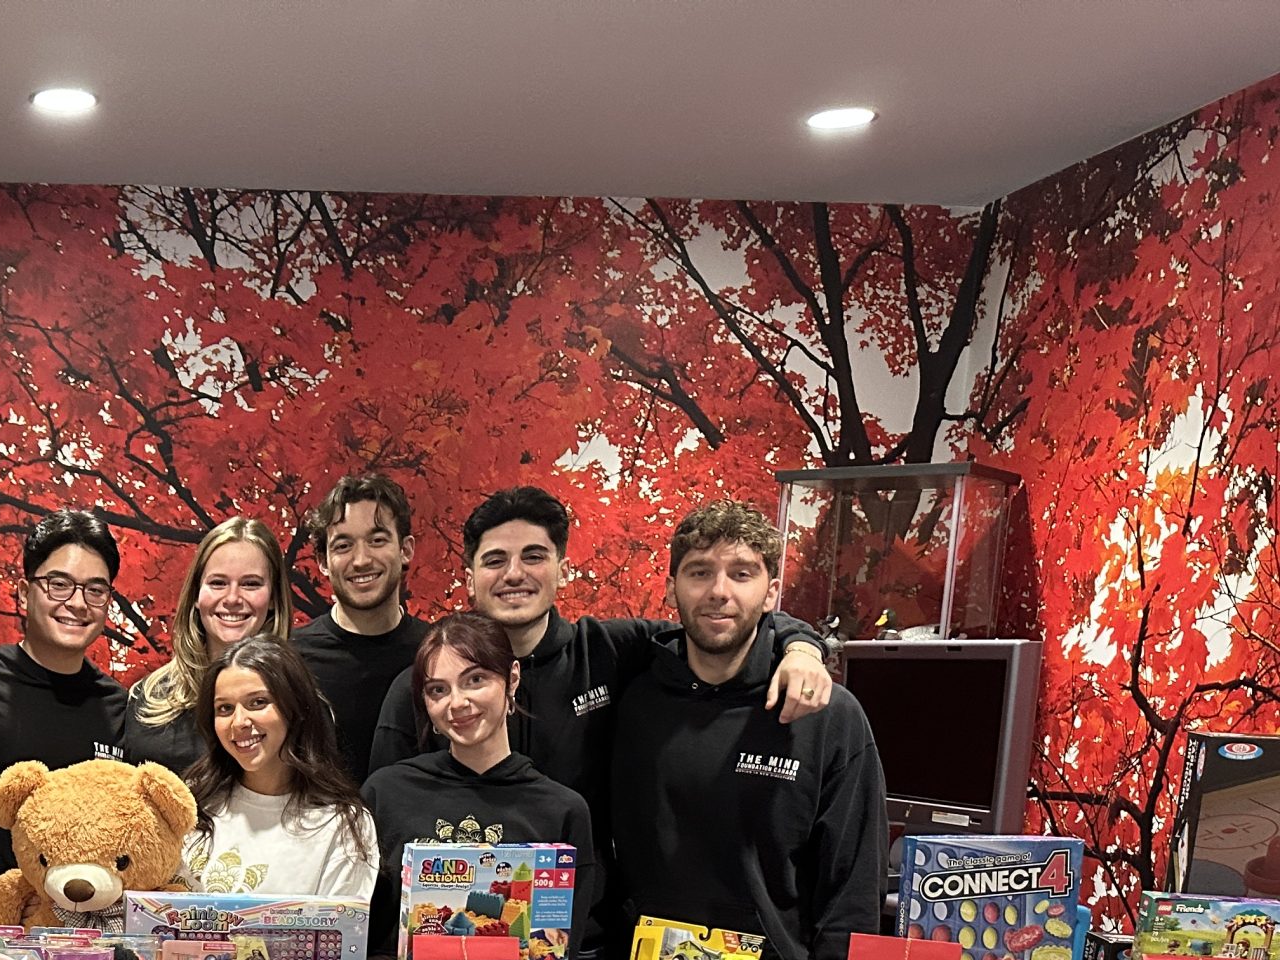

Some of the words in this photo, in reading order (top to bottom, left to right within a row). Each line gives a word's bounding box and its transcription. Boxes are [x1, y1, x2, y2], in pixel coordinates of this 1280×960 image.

[739, 752, 763, 765] THE
[768, 755, 800, 771] MIND
[736, 762, 773, 772] FOUNDATION
[773, 766, 797, 777] CANADA
[421, 856, 470, 875] SAND
[538, 855, 552, 863] 3+
[947, 858, 963, 868] The
[964, 855, 995, 866] classic
[996, 853, 1020, 866] game
[1021, 852, 1032, 861] of
[418, 865, 474, 883] sational
[923, 867, 1042, 898] CONNECT
[1038, 853, 1069, 894] 4
[132, 903, 145, 912] 7+
[1175, 903, 1205, 914] Friends
[165, 905, 244, 927] Rainbow
[263, 916, 296, 925] BEAD
[297, 917, 337, 926] STORY
[180, 919, 230, 931] Loom
